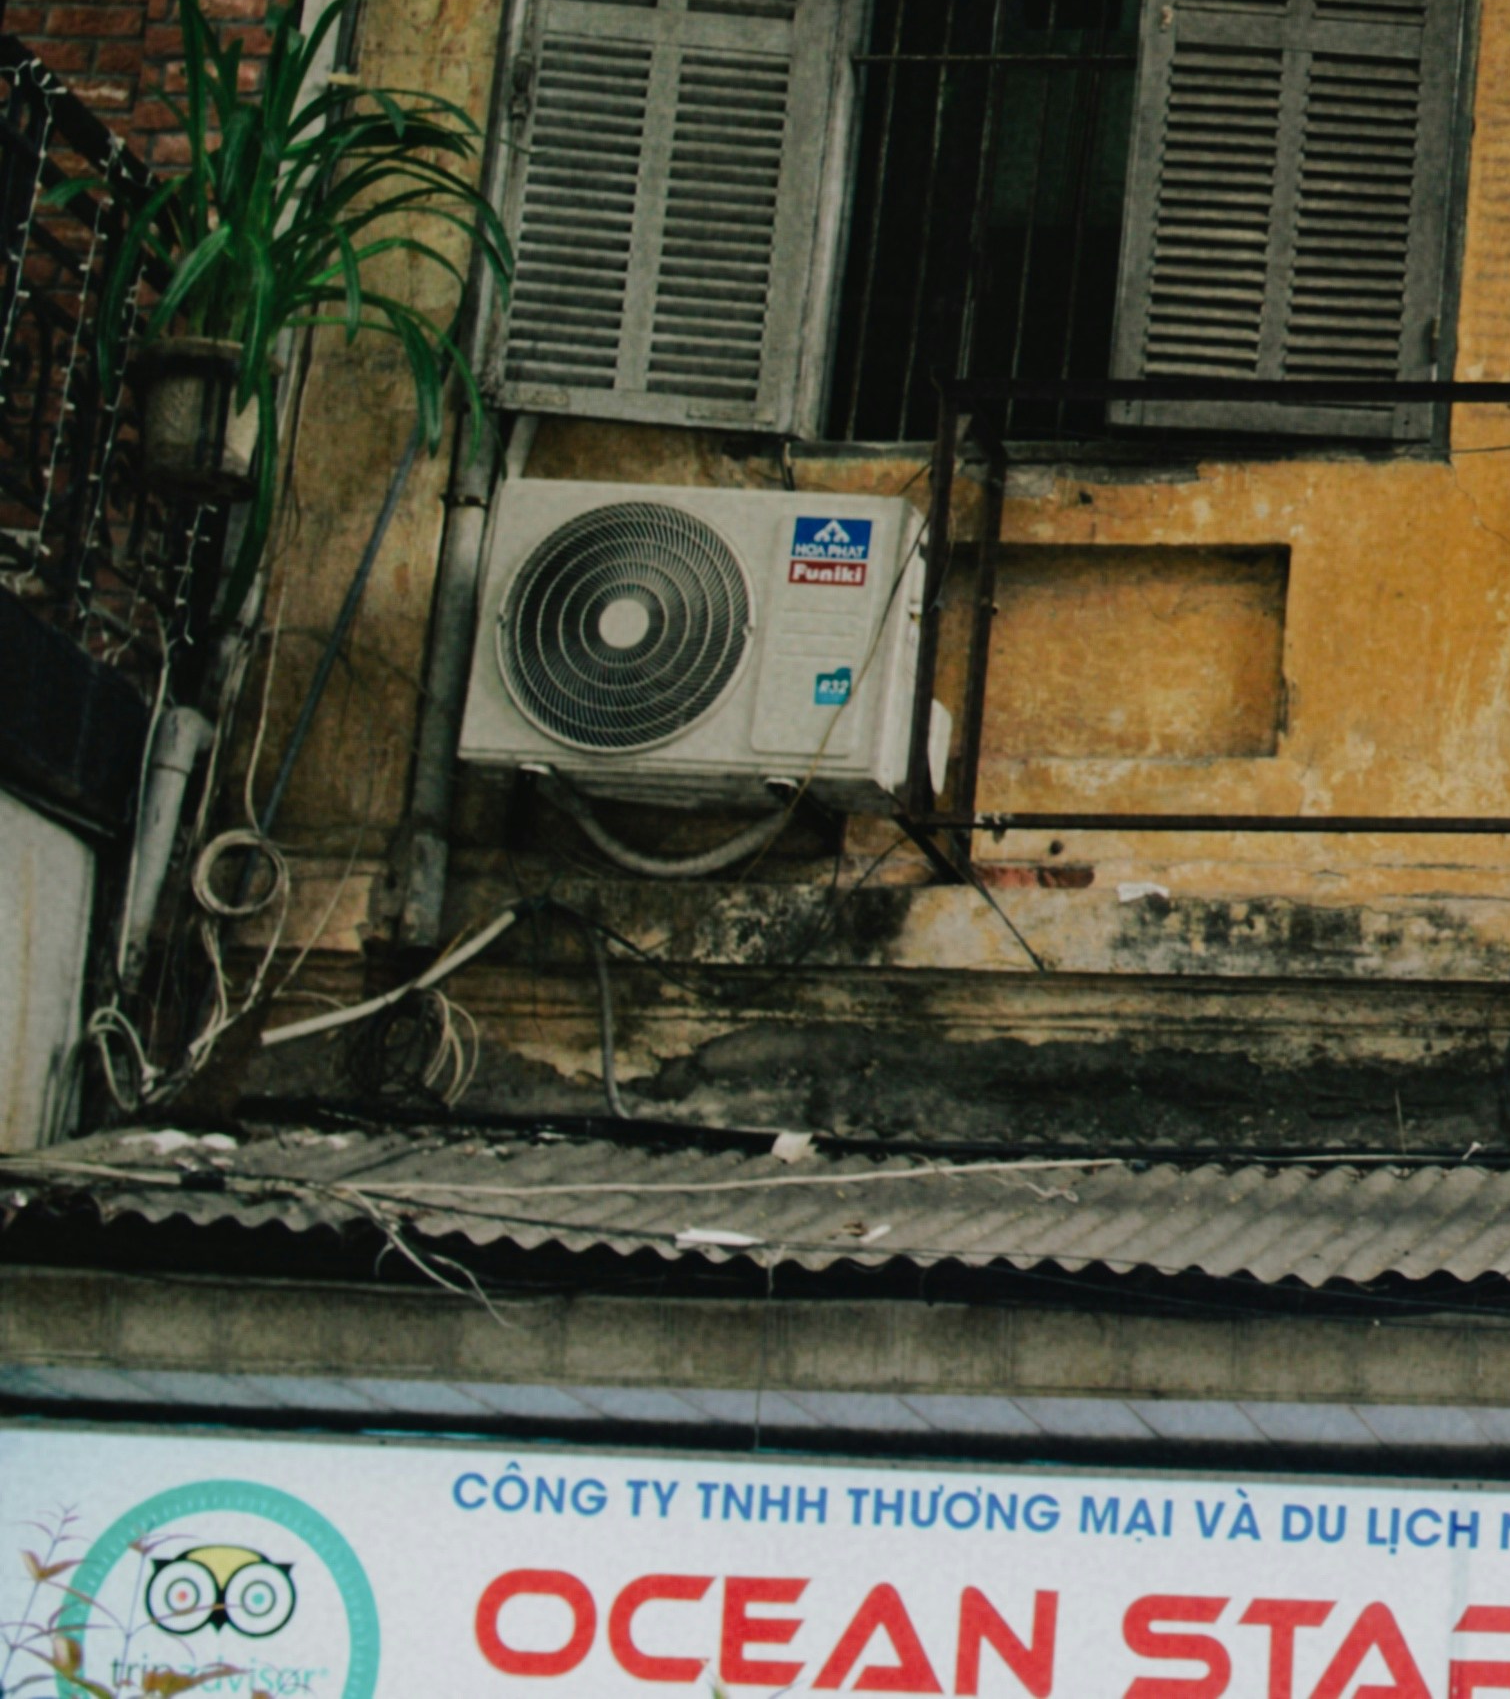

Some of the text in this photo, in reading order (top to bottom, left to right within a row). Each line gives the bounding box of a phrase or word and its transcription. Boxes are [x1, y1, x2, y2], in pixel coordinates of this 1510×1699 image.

[792, 563, 862, 583] Funiki
[818, 679, 850, 695] R32
[452, 1460, 608, 1516] CÔNG
[625, 1479, 679, 1518] TY
[696, 1481, 828, 1524] TNHH
[846, 1485, 1061, 1533] THƯƠNG
[1079, 1495, 1174, 1543] MẠI
[1195, 1488, 1261, 1541] VÀ
[1280, 1504, 1347, 1543] DU
[1366, 1507, 1480, 1555] LỊCH
[475, 1568, 1059, 1699] OCEAN
